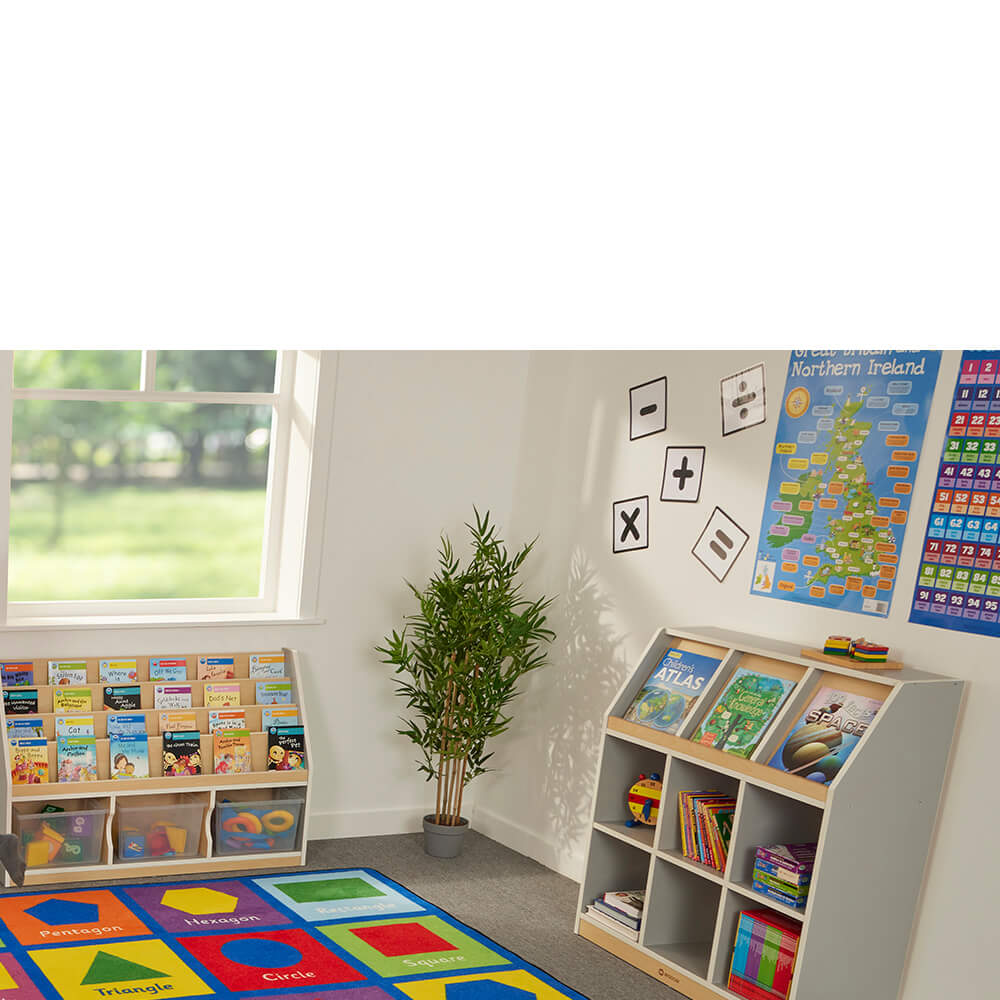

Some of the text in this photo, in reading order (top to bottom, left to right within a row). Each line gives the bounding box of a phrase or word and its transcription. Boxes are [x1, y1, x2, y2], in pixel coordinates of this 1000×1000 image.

[791, 357, 926, 377] Northern Ireland
[962, 389, 969, 398] 11
[978, 389, 988, 398] 12
[955, 415, 965, 424] 21
[971, 416, 984, 425] 22
[950, 441, 959, 450] 31
[966, 441, 979, 451] 32
[984, 442, 996, 451] 33
[944, 466, 954, 476] 41
[960, 468, 973, 477] 42
[978, 469, 991, 478] 43
[939, 492, 950, 501] 51
[955, 493, 968, 502] 52
[972, 494, 986, 504] 53
[934, 517, 944, 526] 61
[950, 519, 963, 528] 62
[967, 520, 980, 529] 63
[984, 522, 998, 531] 64
[930, 542, 939, 551] 71
[945, 544, 957, 553] 72
[962, 546, 974, 555] 73
[980, 548, 992, 557] 74
[924, 567, 934, 576] 81
[940, 568, 952, 578] 82
[956, 571, 969, 580] 83
[973, 573, 987, 582] 84
[920, 591, 929, 600] 91
[934, 593, 947, 602] 92
[951, 596, 963, 605] 93
[968, 598, 980, 608] 94
[985, 601, 998, 610] 95
[654, 667, 704, 690] ATLAS
[806, 710, 869, 736] SPACE
[316, 900, 400, 916] Rectangle
[182, 913, 262, 927] Hexagon
[37, 922, 125, 940] Pentagon
[402, 955, 465, 968] Square
[261, 970, 316, 982] Circle
[93, 981, 176, 999] Triangle
